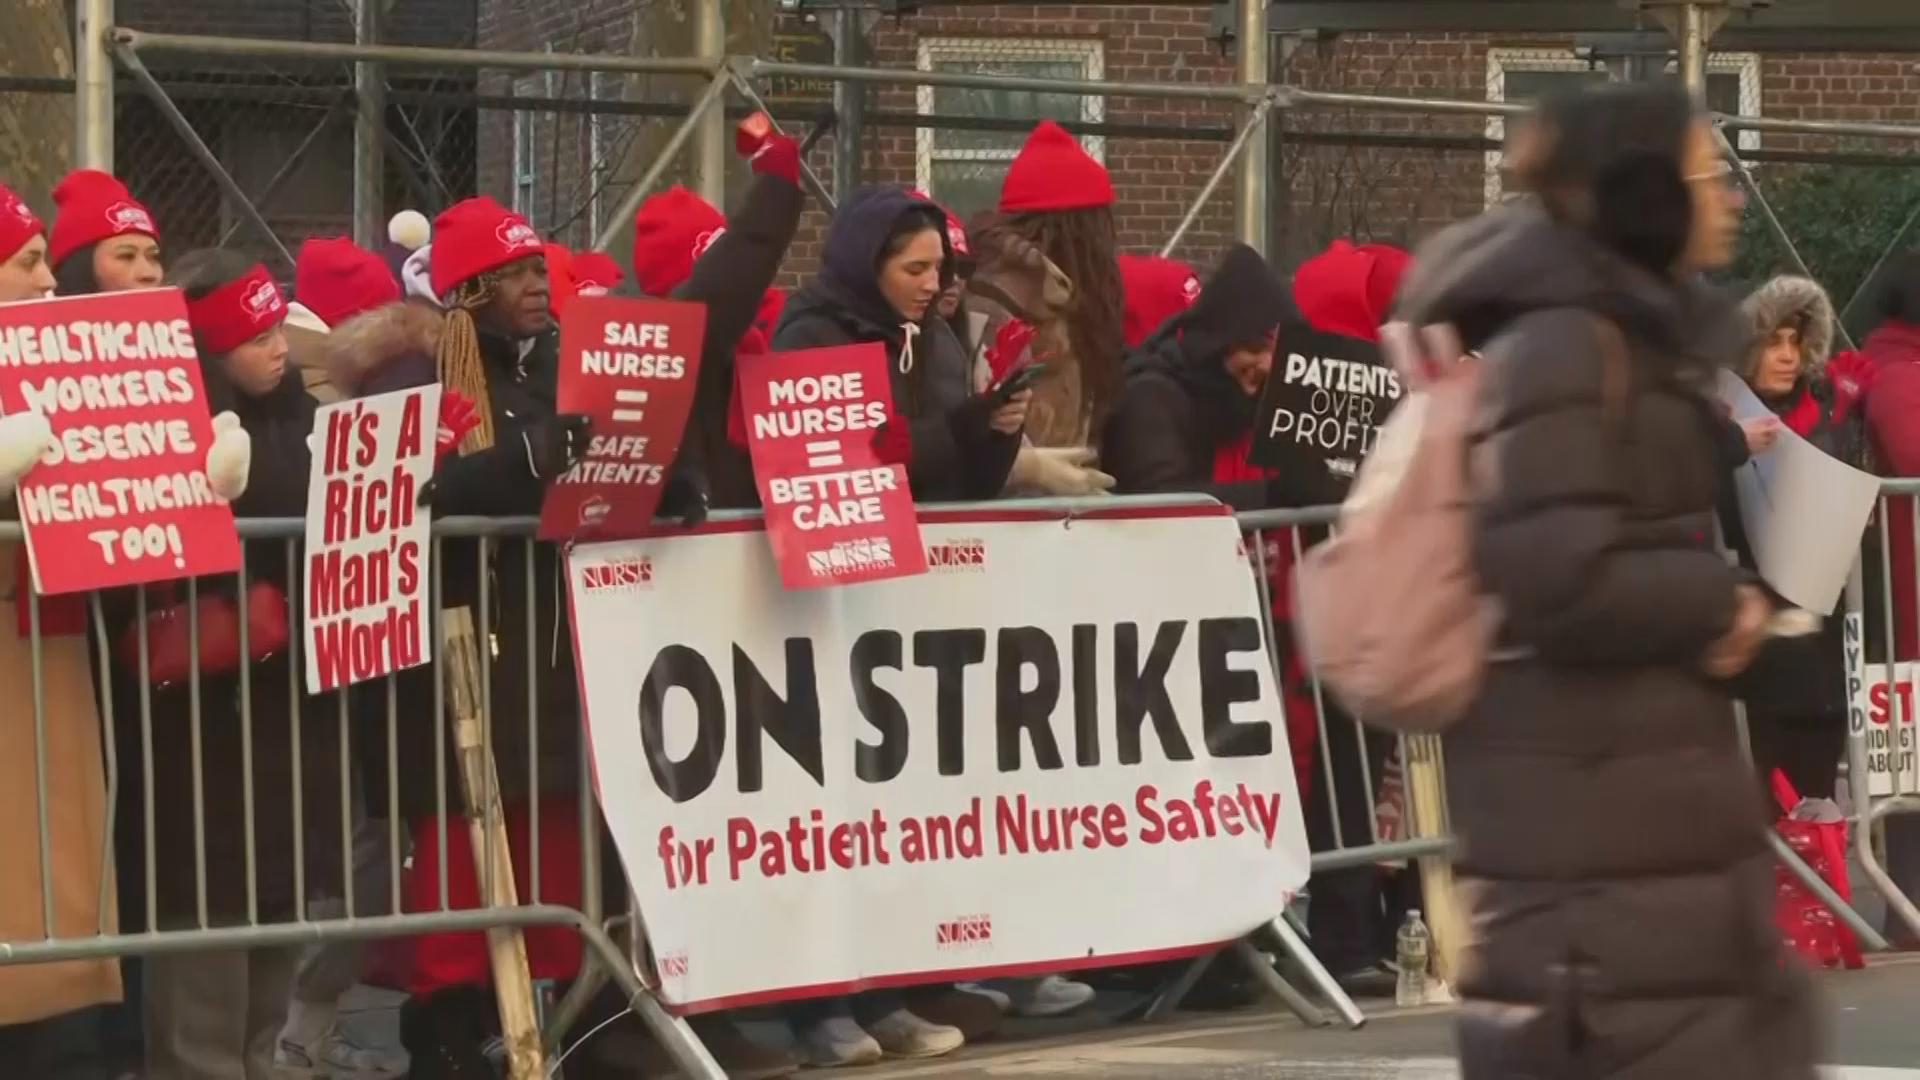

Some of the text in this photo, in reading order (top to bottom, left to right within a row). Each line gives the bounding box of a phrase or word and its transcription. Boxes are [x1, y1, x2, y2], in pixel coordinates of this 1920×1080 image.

[0, 319, 197, 367] HEALTHCARE
[604, 321, 670, 349] SAFE
[581, 349, 686, 379] NURSES
[1284, 353, 1400, 399] PATIENTS
[20, 367, 194, 416] WORKERS
[768, 372, 864, 406] MORE
[1311, 388, 1375, 425] OVER
[324, 393, 422, 475] It's A
[753, 401, 888, 440] NURSES
[587, 435, 648, 460] SAFE
[23, 471, 222, 525] HEALTHCAR
[323, 464, 415, 545] Rich
[769, 466, 897, 504] BETTER
[792, 497, 884, 531] CARE
[88, 523, 185, 569] TOO!
[929, 544, 986, 567] NURSES
[309, 534, 419, 619] Man's
[582, 562, 654, 589] NURSES
[313, 599, 421, 692] World
[1845, 617, 1864, 732] NYPD
[638, 617, 1273, 803] ON STRIKE
[658, 779, 1281, 890] for Patient and Nurse Safety
